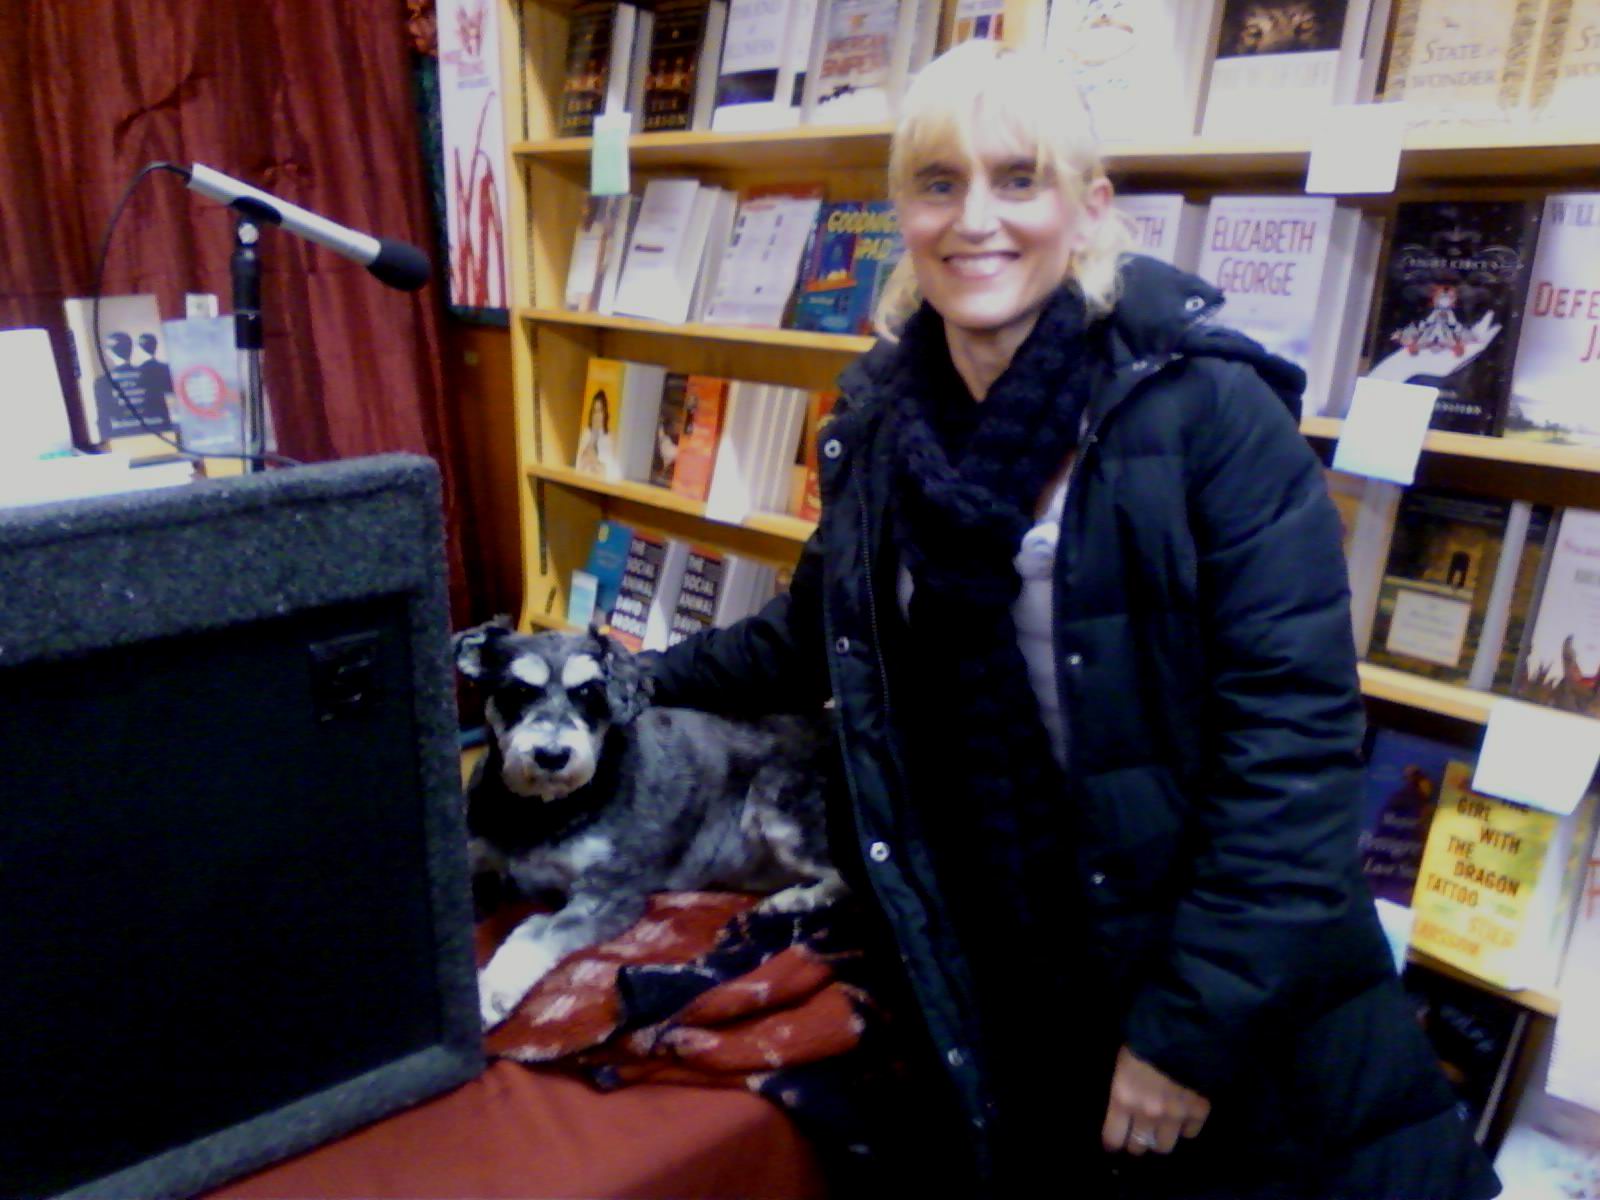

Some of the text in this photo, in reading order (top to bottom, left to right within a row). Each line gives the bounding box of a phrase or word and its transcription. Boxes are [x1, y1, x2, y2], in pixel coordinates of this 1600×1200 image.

[1411, 68, 1498, 88] WONDER
[1211, 216, 1317, 254] ELIZABETH
[1217, 257, 1297, 297] GEORGE
[1457, 797, 1491, 822] GIRL
[1448, 835, 1475, 859] THE
[1479, 826, 1522, 855] WITH
[1426, 872, 1479, 907] TATTOO
[1454, 860, 1521, 898] DRAGON
